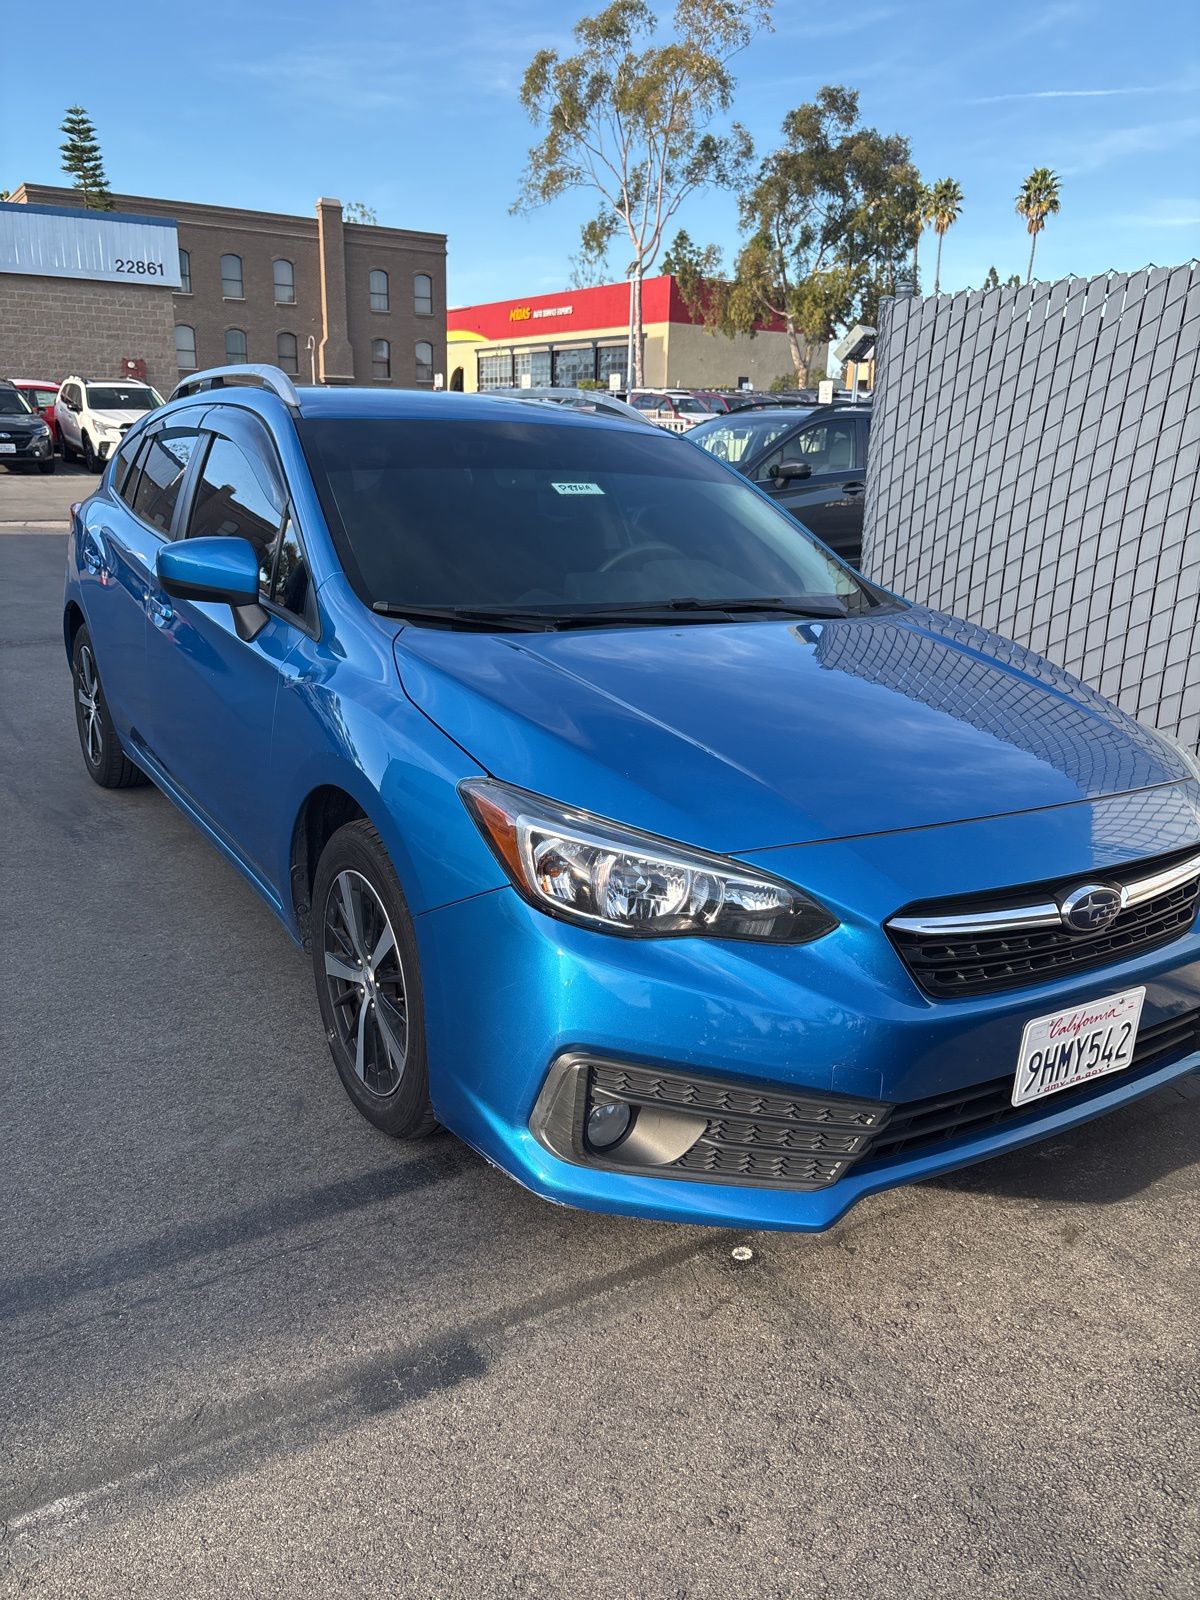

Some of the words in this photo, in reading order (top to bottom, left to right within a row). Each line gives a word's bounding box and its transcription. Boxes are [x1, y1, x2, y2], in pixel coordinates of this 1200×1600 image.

[115, 259, 164, 276] 22861
[510, 307, 531, 321] MIDAS
[1049, 1007, 1121, 1039] California
[1023, 1021, 1132, 1093] 9HMY542
[1043, 1067, 1105, 1093] dmv.ca.gov
